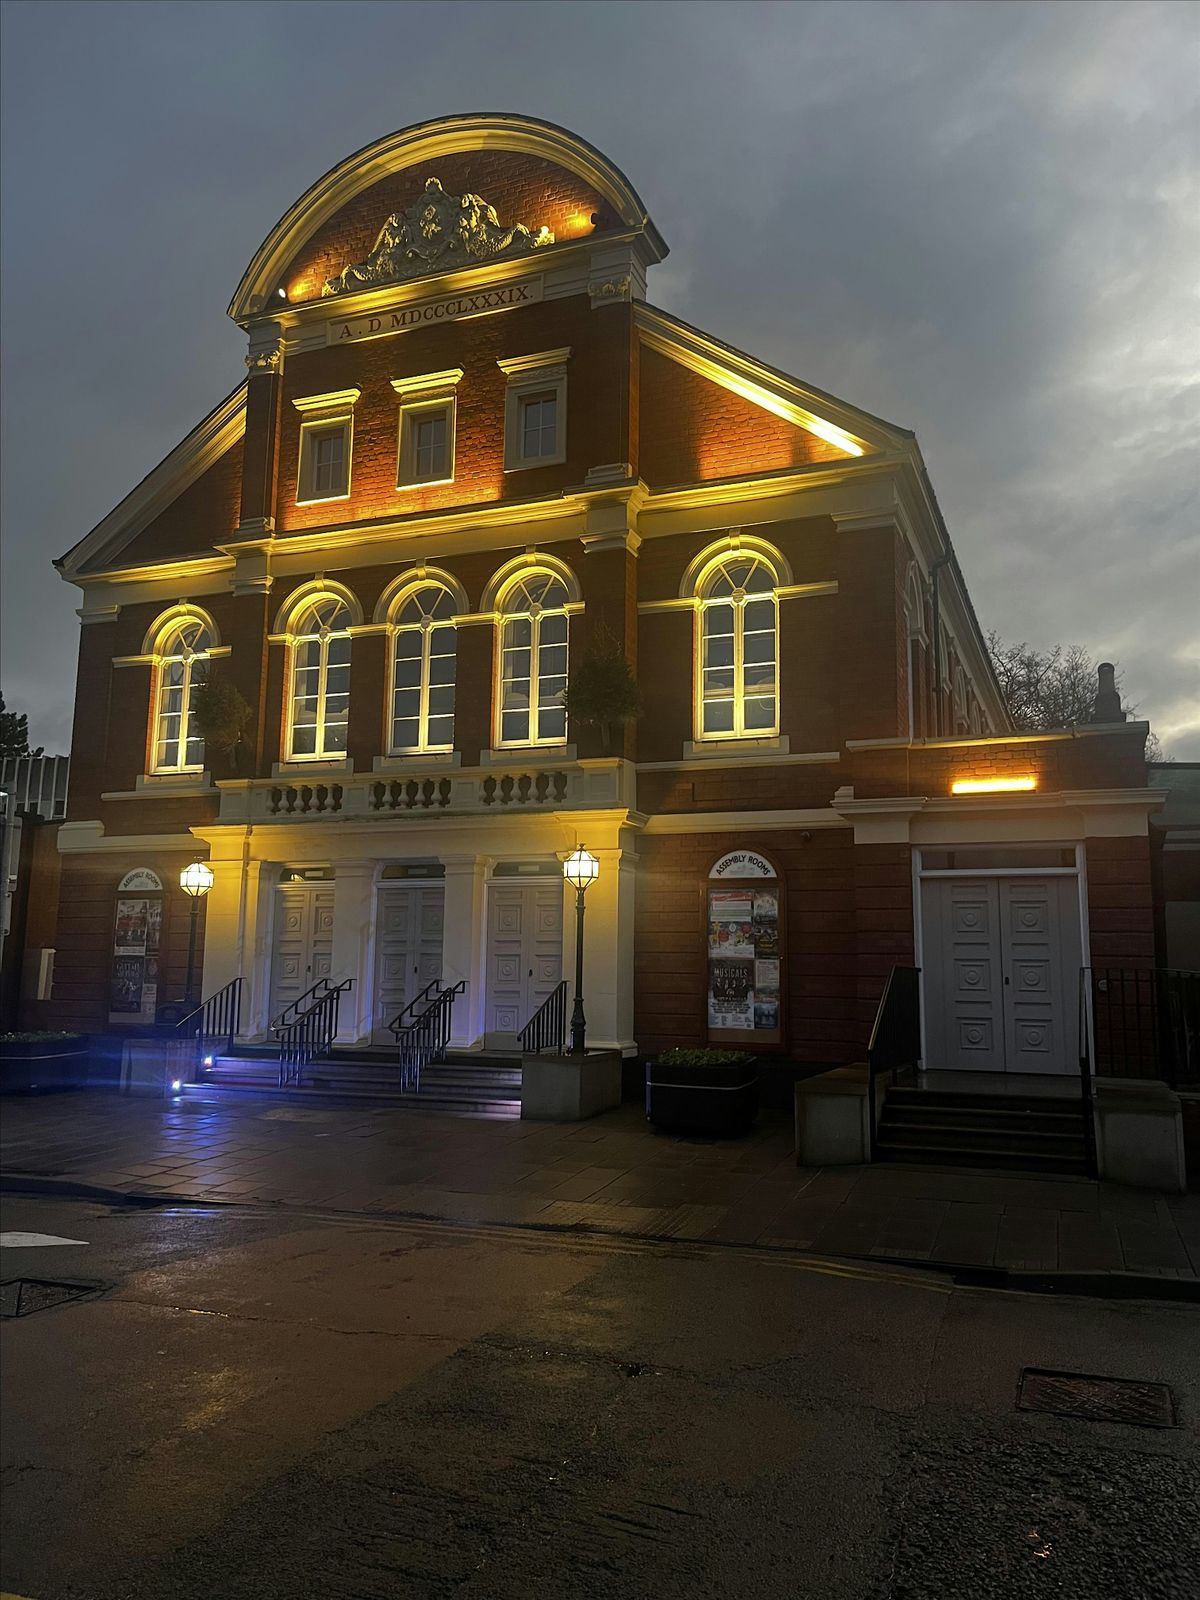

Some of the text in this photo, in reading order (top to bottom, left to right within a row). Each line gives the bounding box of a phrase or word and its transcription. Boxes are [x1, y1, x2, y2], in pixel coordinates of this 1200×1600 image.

[716, 855, 746, 875] ASSEMBLY
[748, 856, 770, 875] ROOMS
[714, 967, 748, 978] MUSICALS
